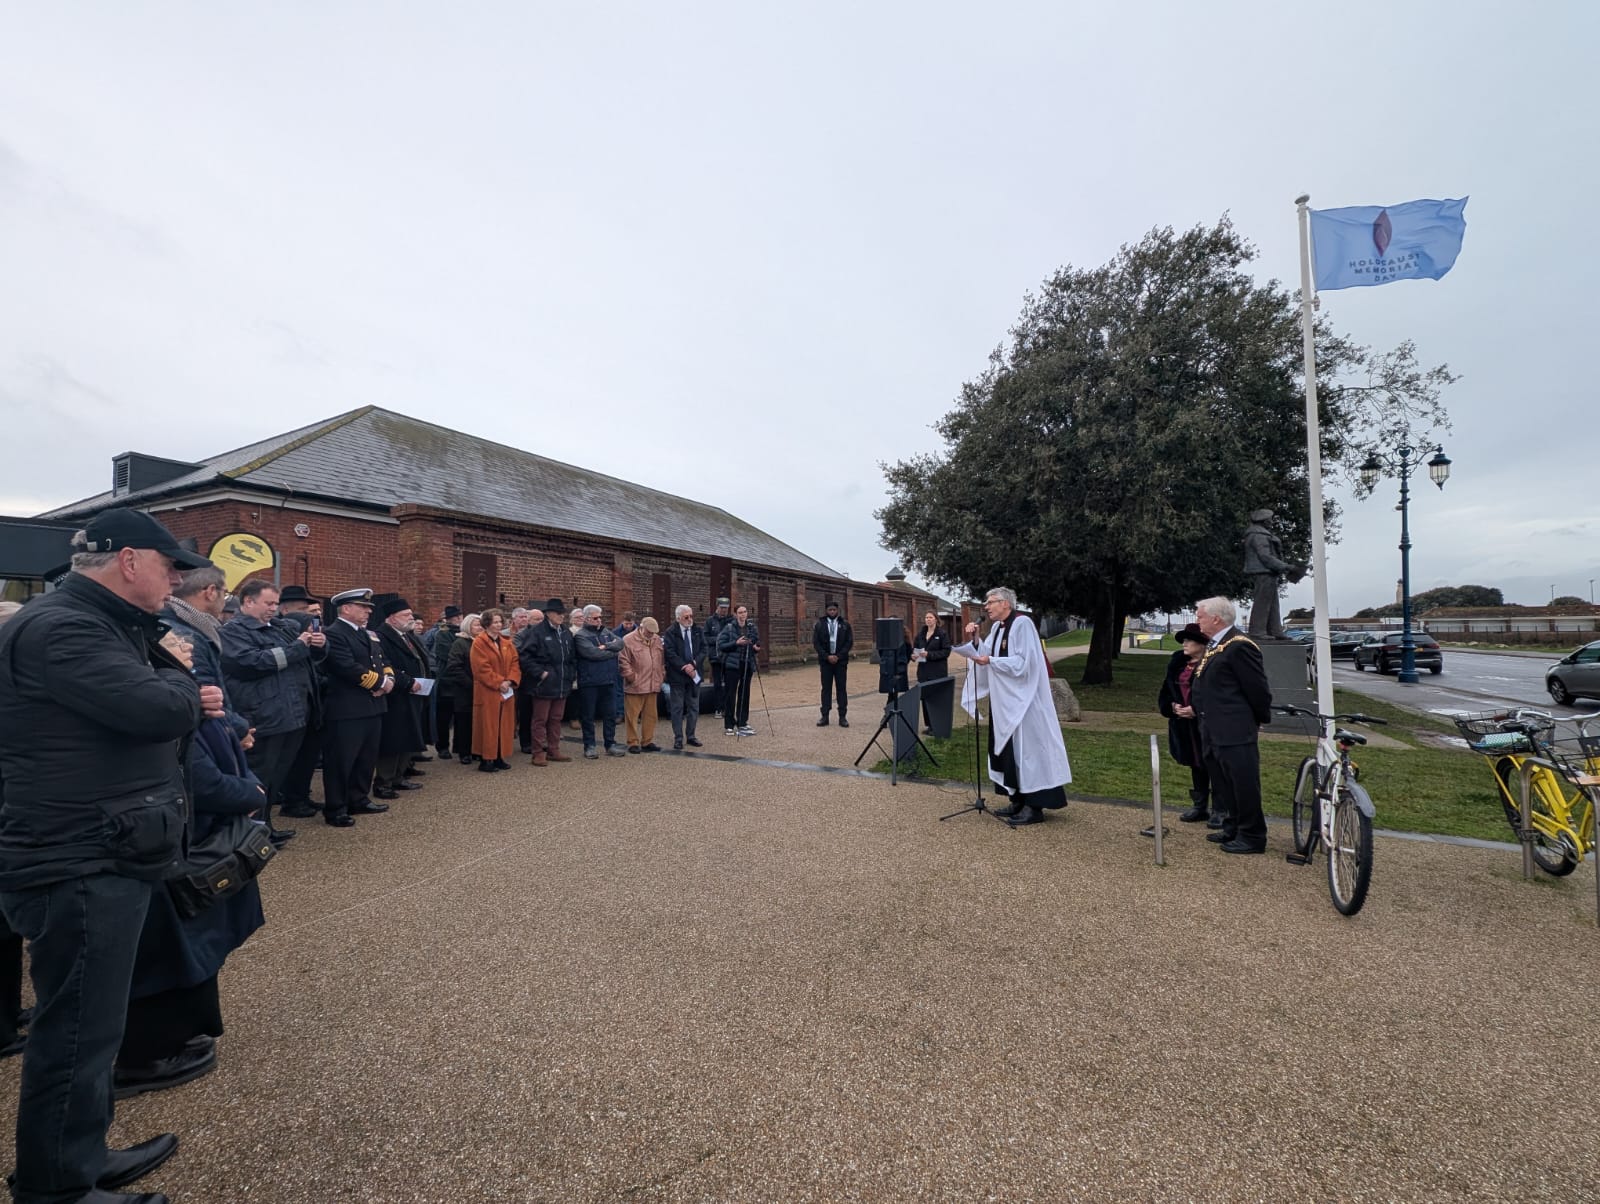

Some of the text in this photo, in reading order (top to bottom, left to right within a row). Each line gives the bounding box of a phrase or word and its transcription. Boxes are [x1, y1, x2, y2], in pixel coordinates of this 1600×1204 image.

[1349, 253, 1420, 268] HOLOCAUST
[1354, 261, 1419, 273] MEMORIAL
[1374, 274, 1396, 282] DAY
